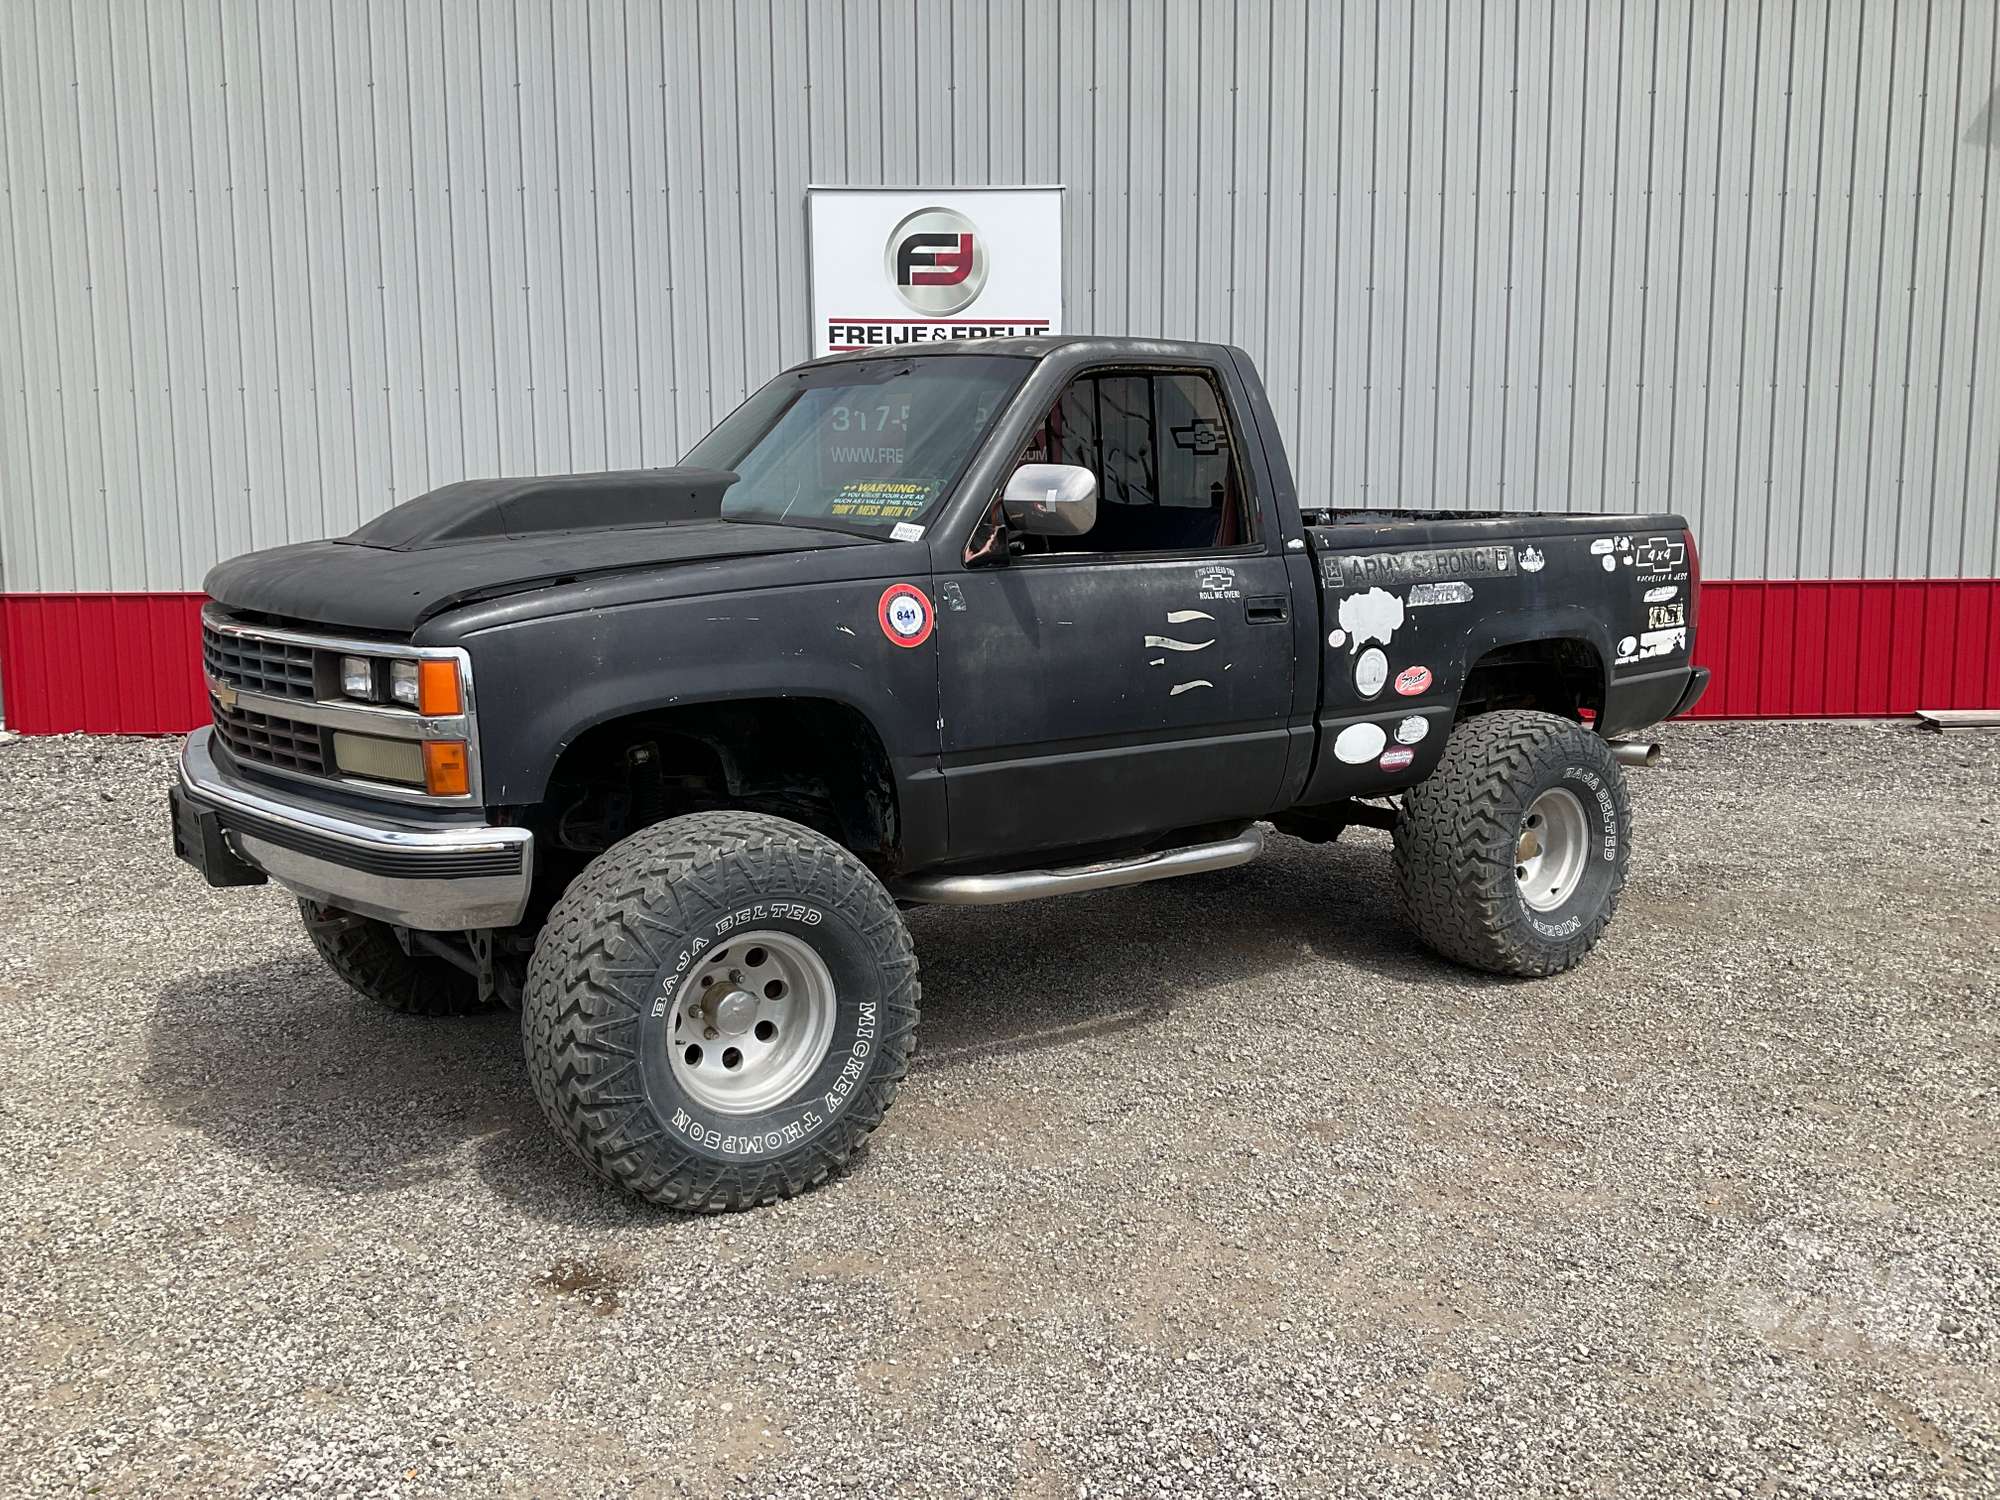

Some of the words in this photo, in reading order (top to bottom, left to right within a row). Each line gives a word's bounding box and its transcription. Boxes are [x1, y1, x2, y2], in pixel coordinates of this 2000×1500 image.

[829, 325, 928, 344] FREIJE
[858, 483, 917, 493] WARNING
[856, 505, 880, 516] MESS
[901, 499, 924, 507] TRUCK
[1351, 557, 1405, 583] ARMY
[1199, 592, 1214, 600] ROLL
[1214, 591, 1223, 600] ME
[897, 609, 916, 621] 841
[1595, 788, 1616, 861] BELTED
[651, 937, 709, 1017] BAJA
[716, 903, 822, 935] BELTED
[825, 1002, 876, 1113] MICKEY
[672, 1107, 822, 1154] THOMPSON
